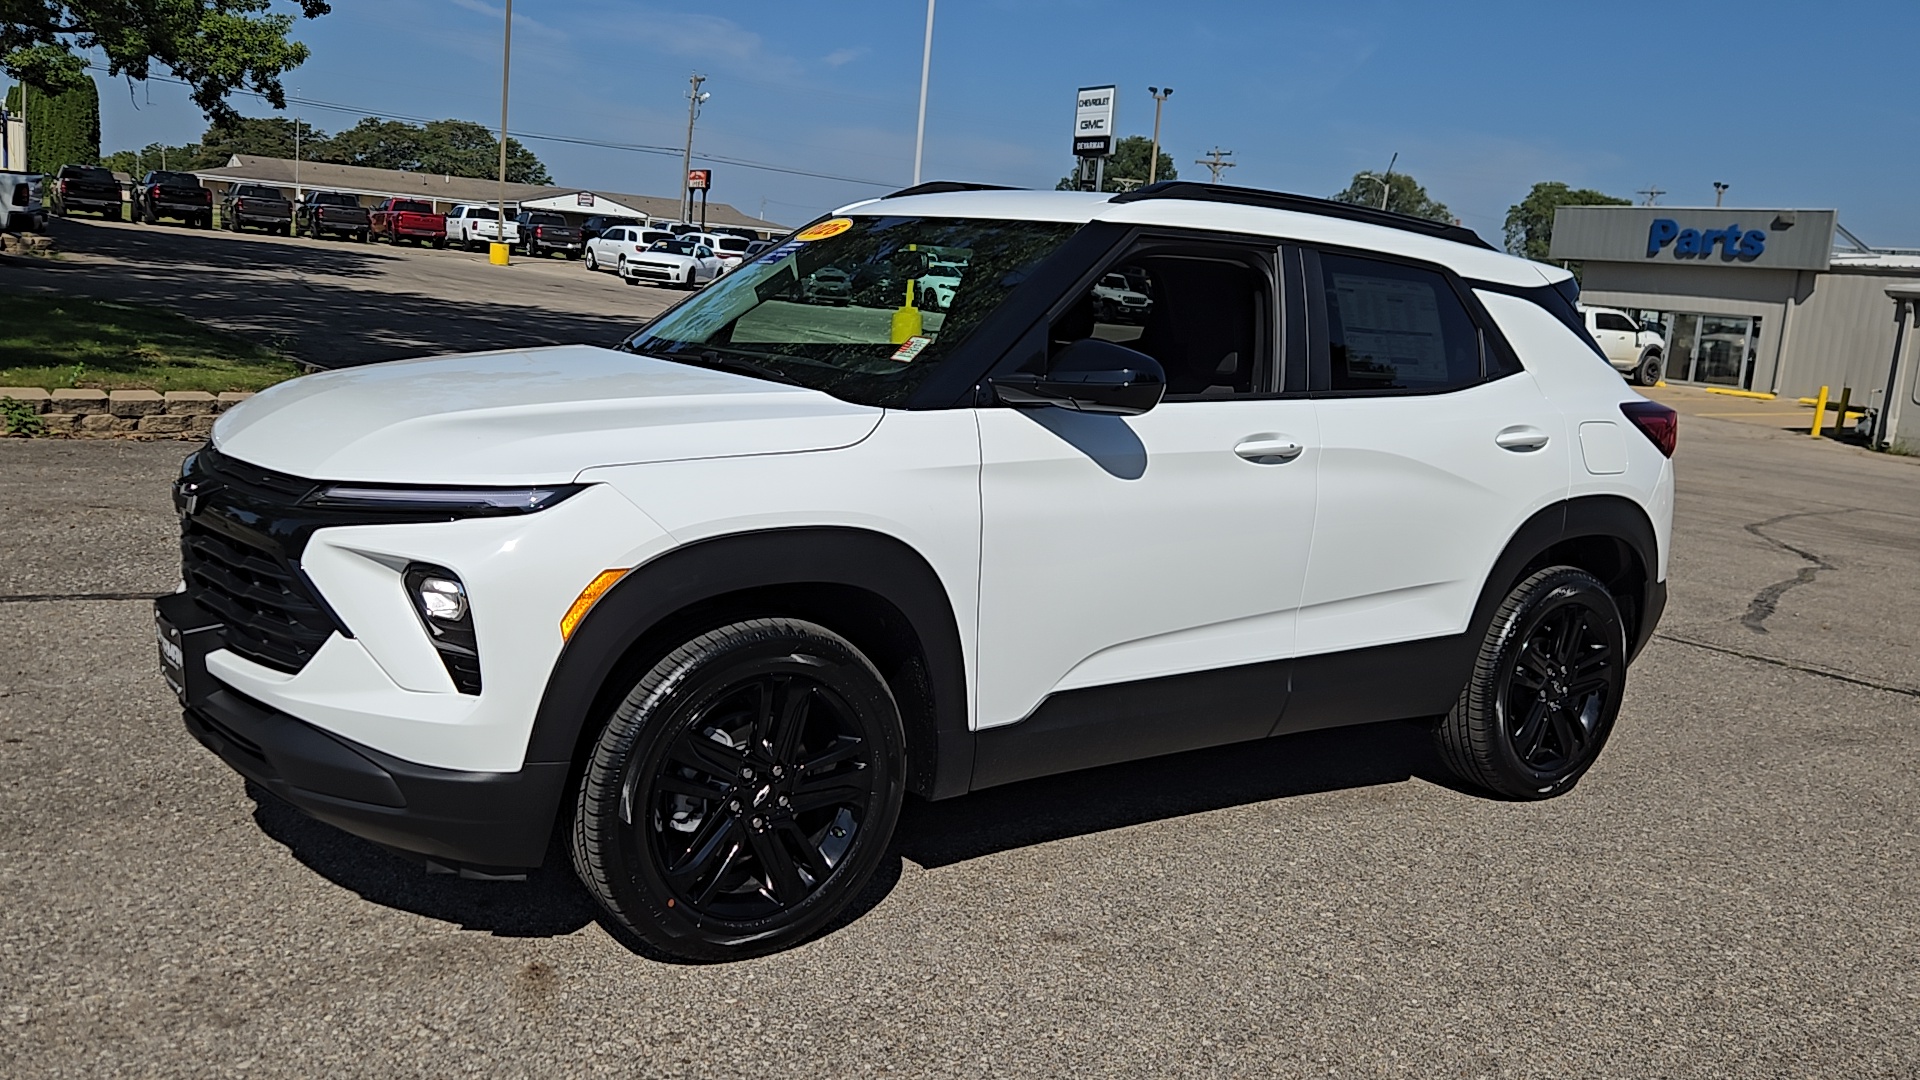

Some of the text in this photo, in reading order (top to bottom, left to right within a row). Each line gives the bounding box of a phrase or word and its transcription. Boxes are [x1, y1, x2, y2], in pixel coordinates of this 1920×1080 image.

[1079, 97, 1110, 107] CHEVROLET
[1081, 119, 1104, 130] GMC
[1648, 218, 1766, 261] Parts
